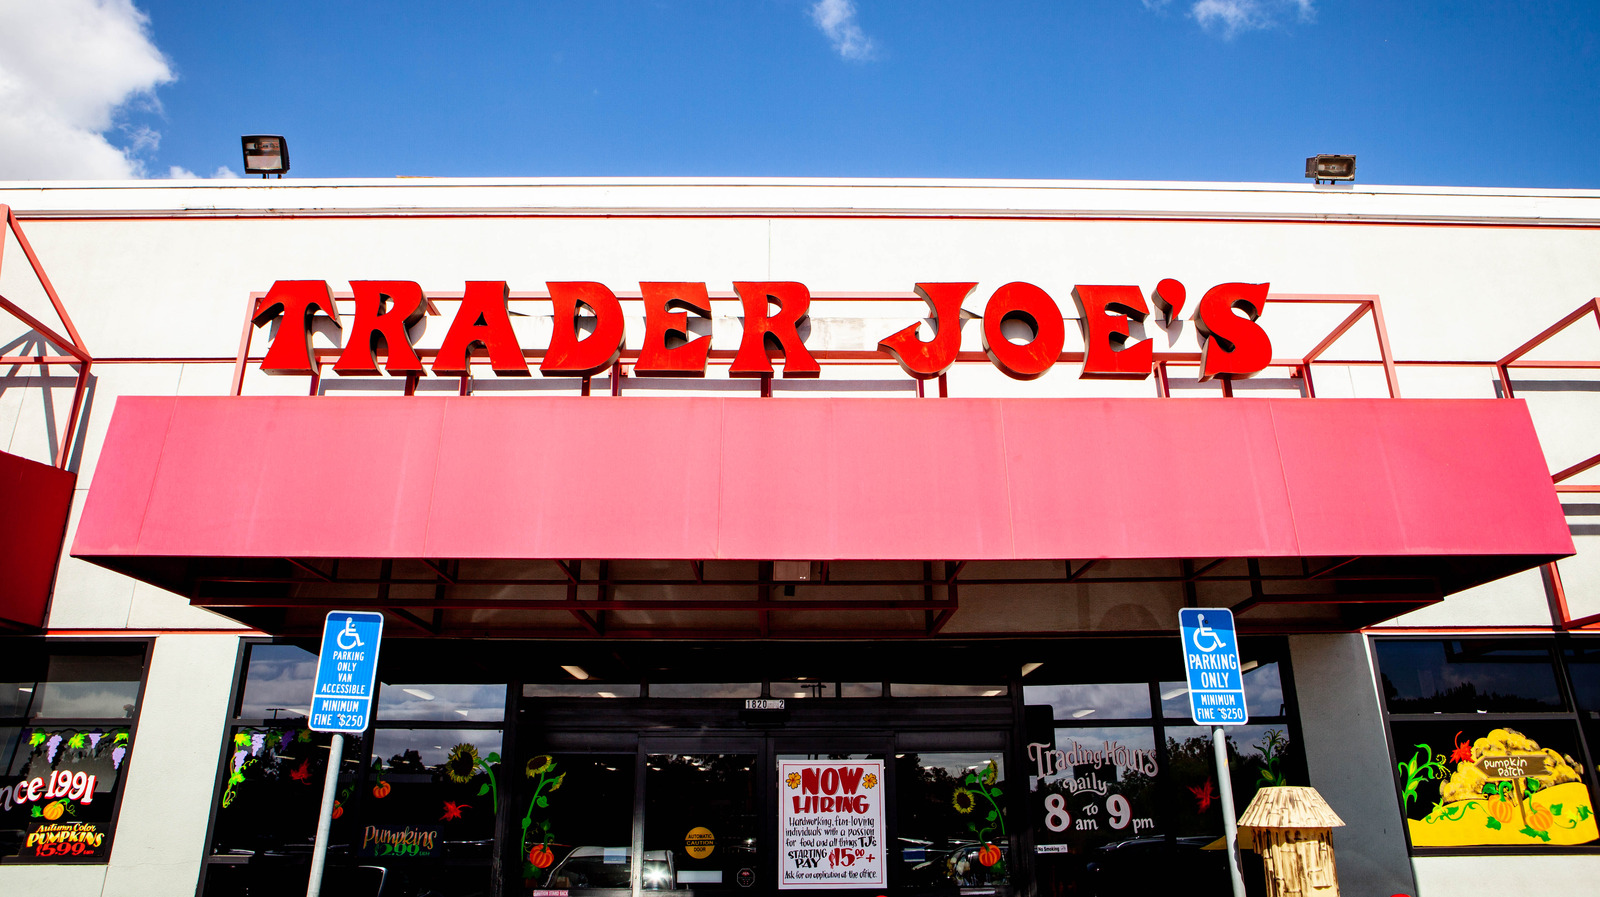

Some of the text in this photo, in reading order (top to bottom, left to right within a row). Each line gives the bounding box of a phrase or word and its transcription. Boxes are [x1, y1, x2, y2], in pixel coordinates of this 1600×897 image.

[251, 278, 1272, 381] TRADER JOE'S
[333, 651, 364, 661] PARKING
[1189, 654, 1236, 670] PARKING
[337, 662, 357, 672] ONLY
[338, 673, 352, 682] VAN
[1201, 672, 1229, 688] ONLY
[321, 683, 365, 694] ACCESSIBLE
[322, 700, 359, 712] MINIMUM
[1201, 694, 1235, 705] MINIMUM
[313, 714, 363, 727] FINE $250
[1197, 708, 1243, 720] FINE $250
[1027, 740, 1158, 780] Trading Hours
[801, 766, 864, 795] NOW
[1062, 772, 1107, 796] Daily
[44, 770, 96, 805] 1991
[792, 795, 870, 814] HIRING
[1044, 793, 1072, 832] 8
[1075, 818, 1099, 831] am
[1106, 793, 1133, 830] 9
[1132, 817, 1155, 834] pm
[36, 822, 96, 833] Autumn Color
[785, 827, 821, 836] individuals
[824, 827, 838, 836] with
[848, 827, 875, 837] passion
[26, 830, 105, 847] PUMPKINS
[363, 825, 437, 850] Pumpkins
[785, 838, 796, 847] for
[800, 838, 815, 847] food
[829, 838, 837, 847] all
[838, 838, 858, 848] things
[35, 842, 86, 857] $5.99
[374, 843, 420, 857] $2.99
[788, 849, 828, 860] STARTING
[795, 858, 821, 869] PAY
[785, 870, 795, 879] Ask
[795, 871, 804, 879] for
[812, 870, 840, 880] application
[848, 870, 858, 878] the
